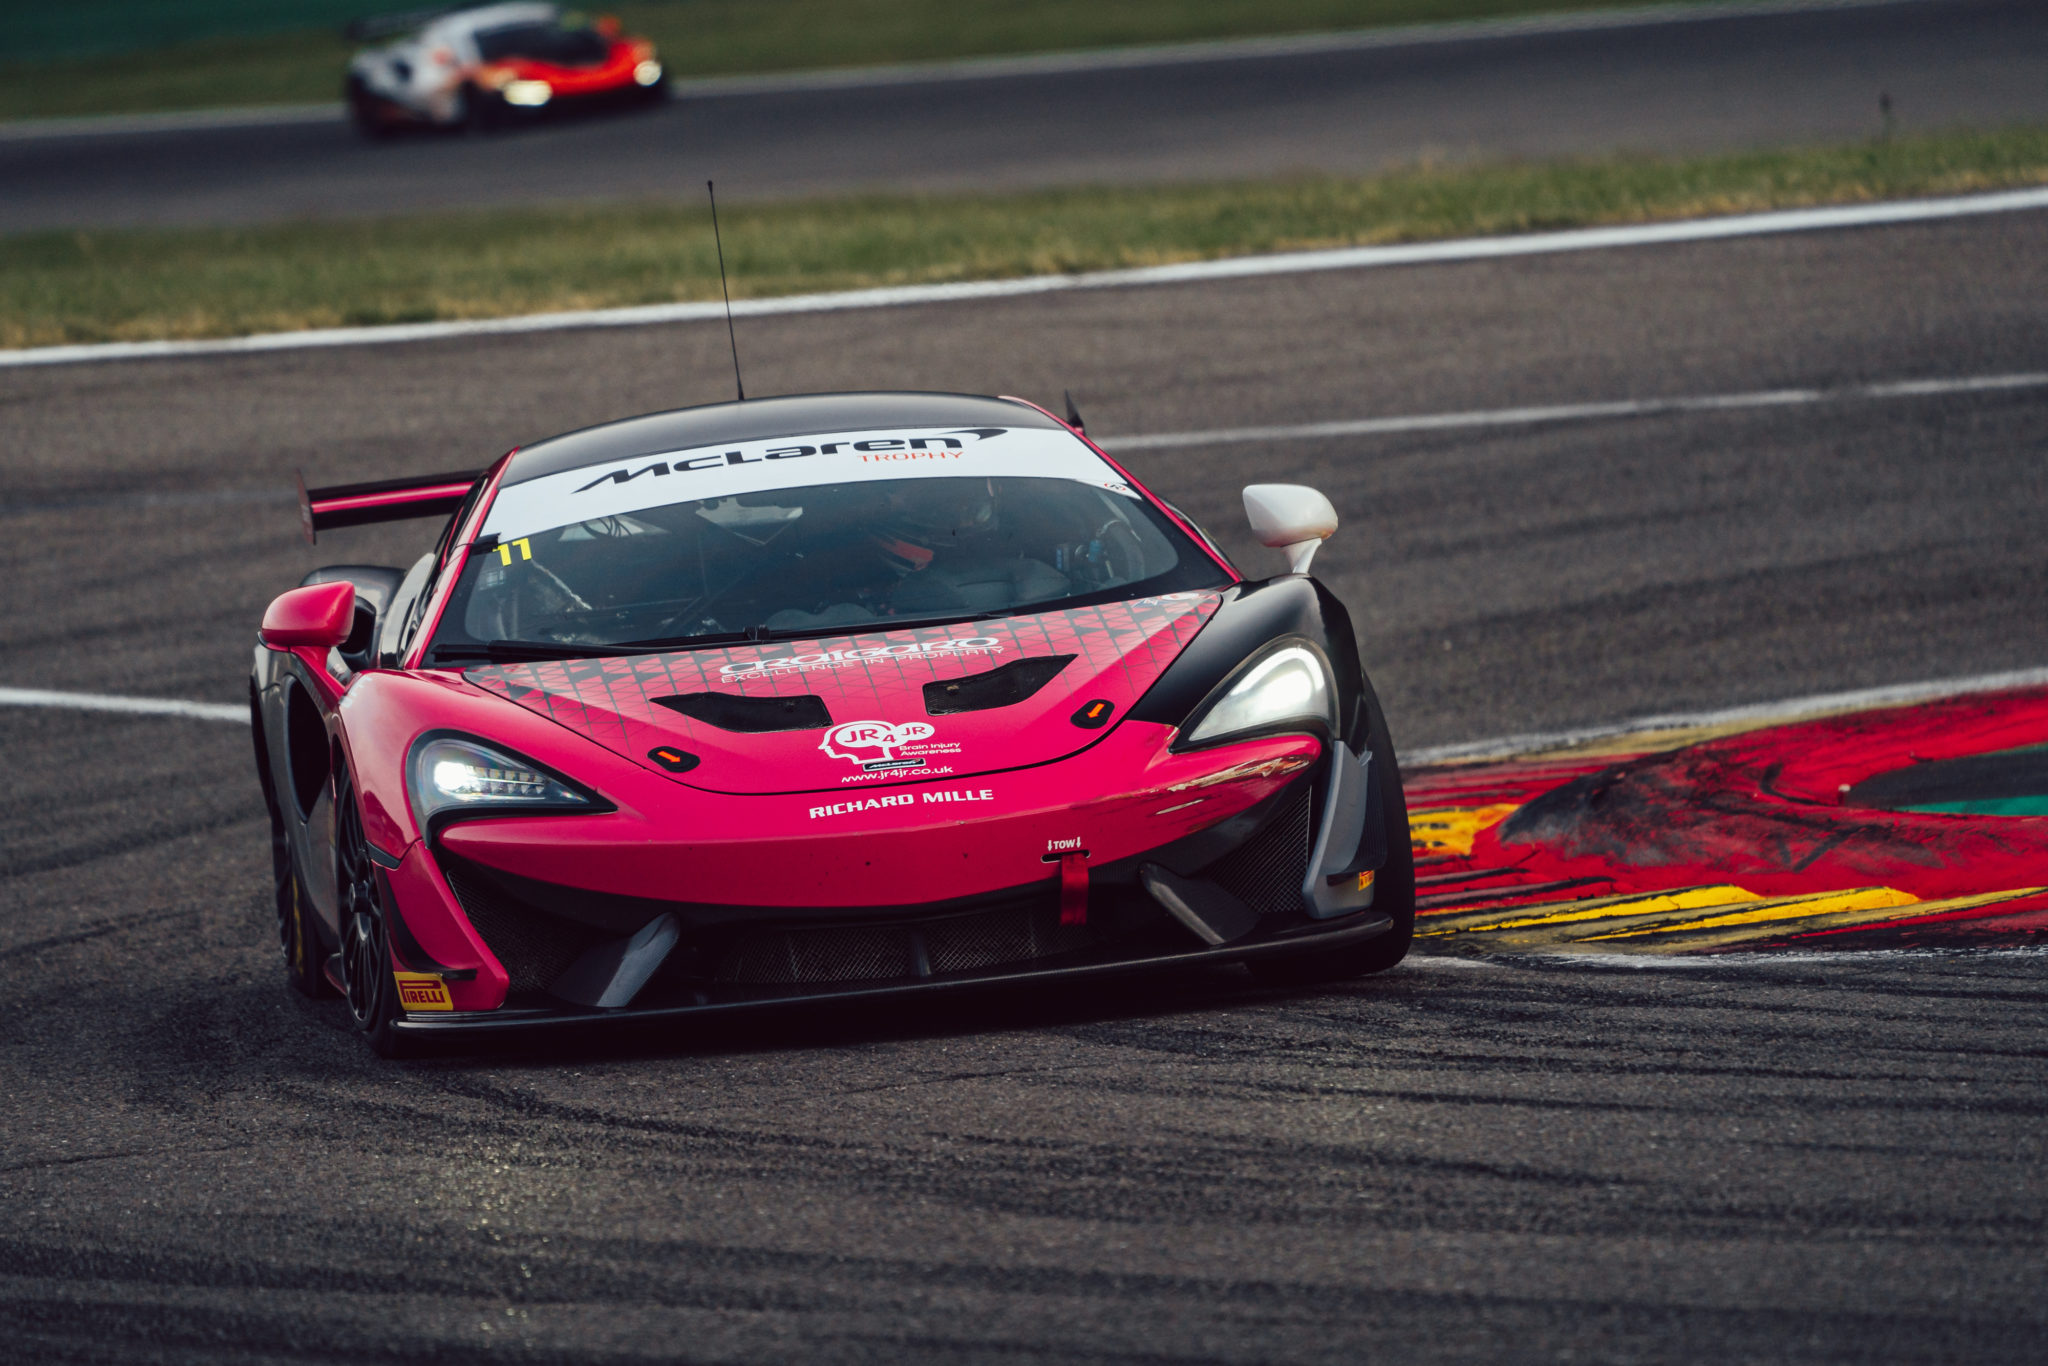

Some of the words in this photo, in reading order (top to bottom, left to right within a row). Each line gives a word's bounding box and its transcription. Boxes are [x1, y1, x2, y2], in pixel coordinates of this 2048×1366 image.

[571, 428, 1008, 494] McLaren
[857, 451, 963, 462] TROPHY
[492, 537, 532, 567] 11
[721, 661, 855, 683] EXCELLENCE
[863, 655, 884, 665] IN
[895, 646, 1004, 662] PROPERTY
[844, 728, 878, 743] JR
[882, 734, 896, 744] 4
[901, 726, 927, 736] JR
[901, 748, 962, 756] Awareness
[841, 765, 954, 783] www.jr4jr.co.uk
[809, 794, 914, 819] RICHARD
[922, 789, 994, 803] MILLE
[1053, 839, 1076, 850] TOW
[398, 980, 446, 1003] PIRELLI
